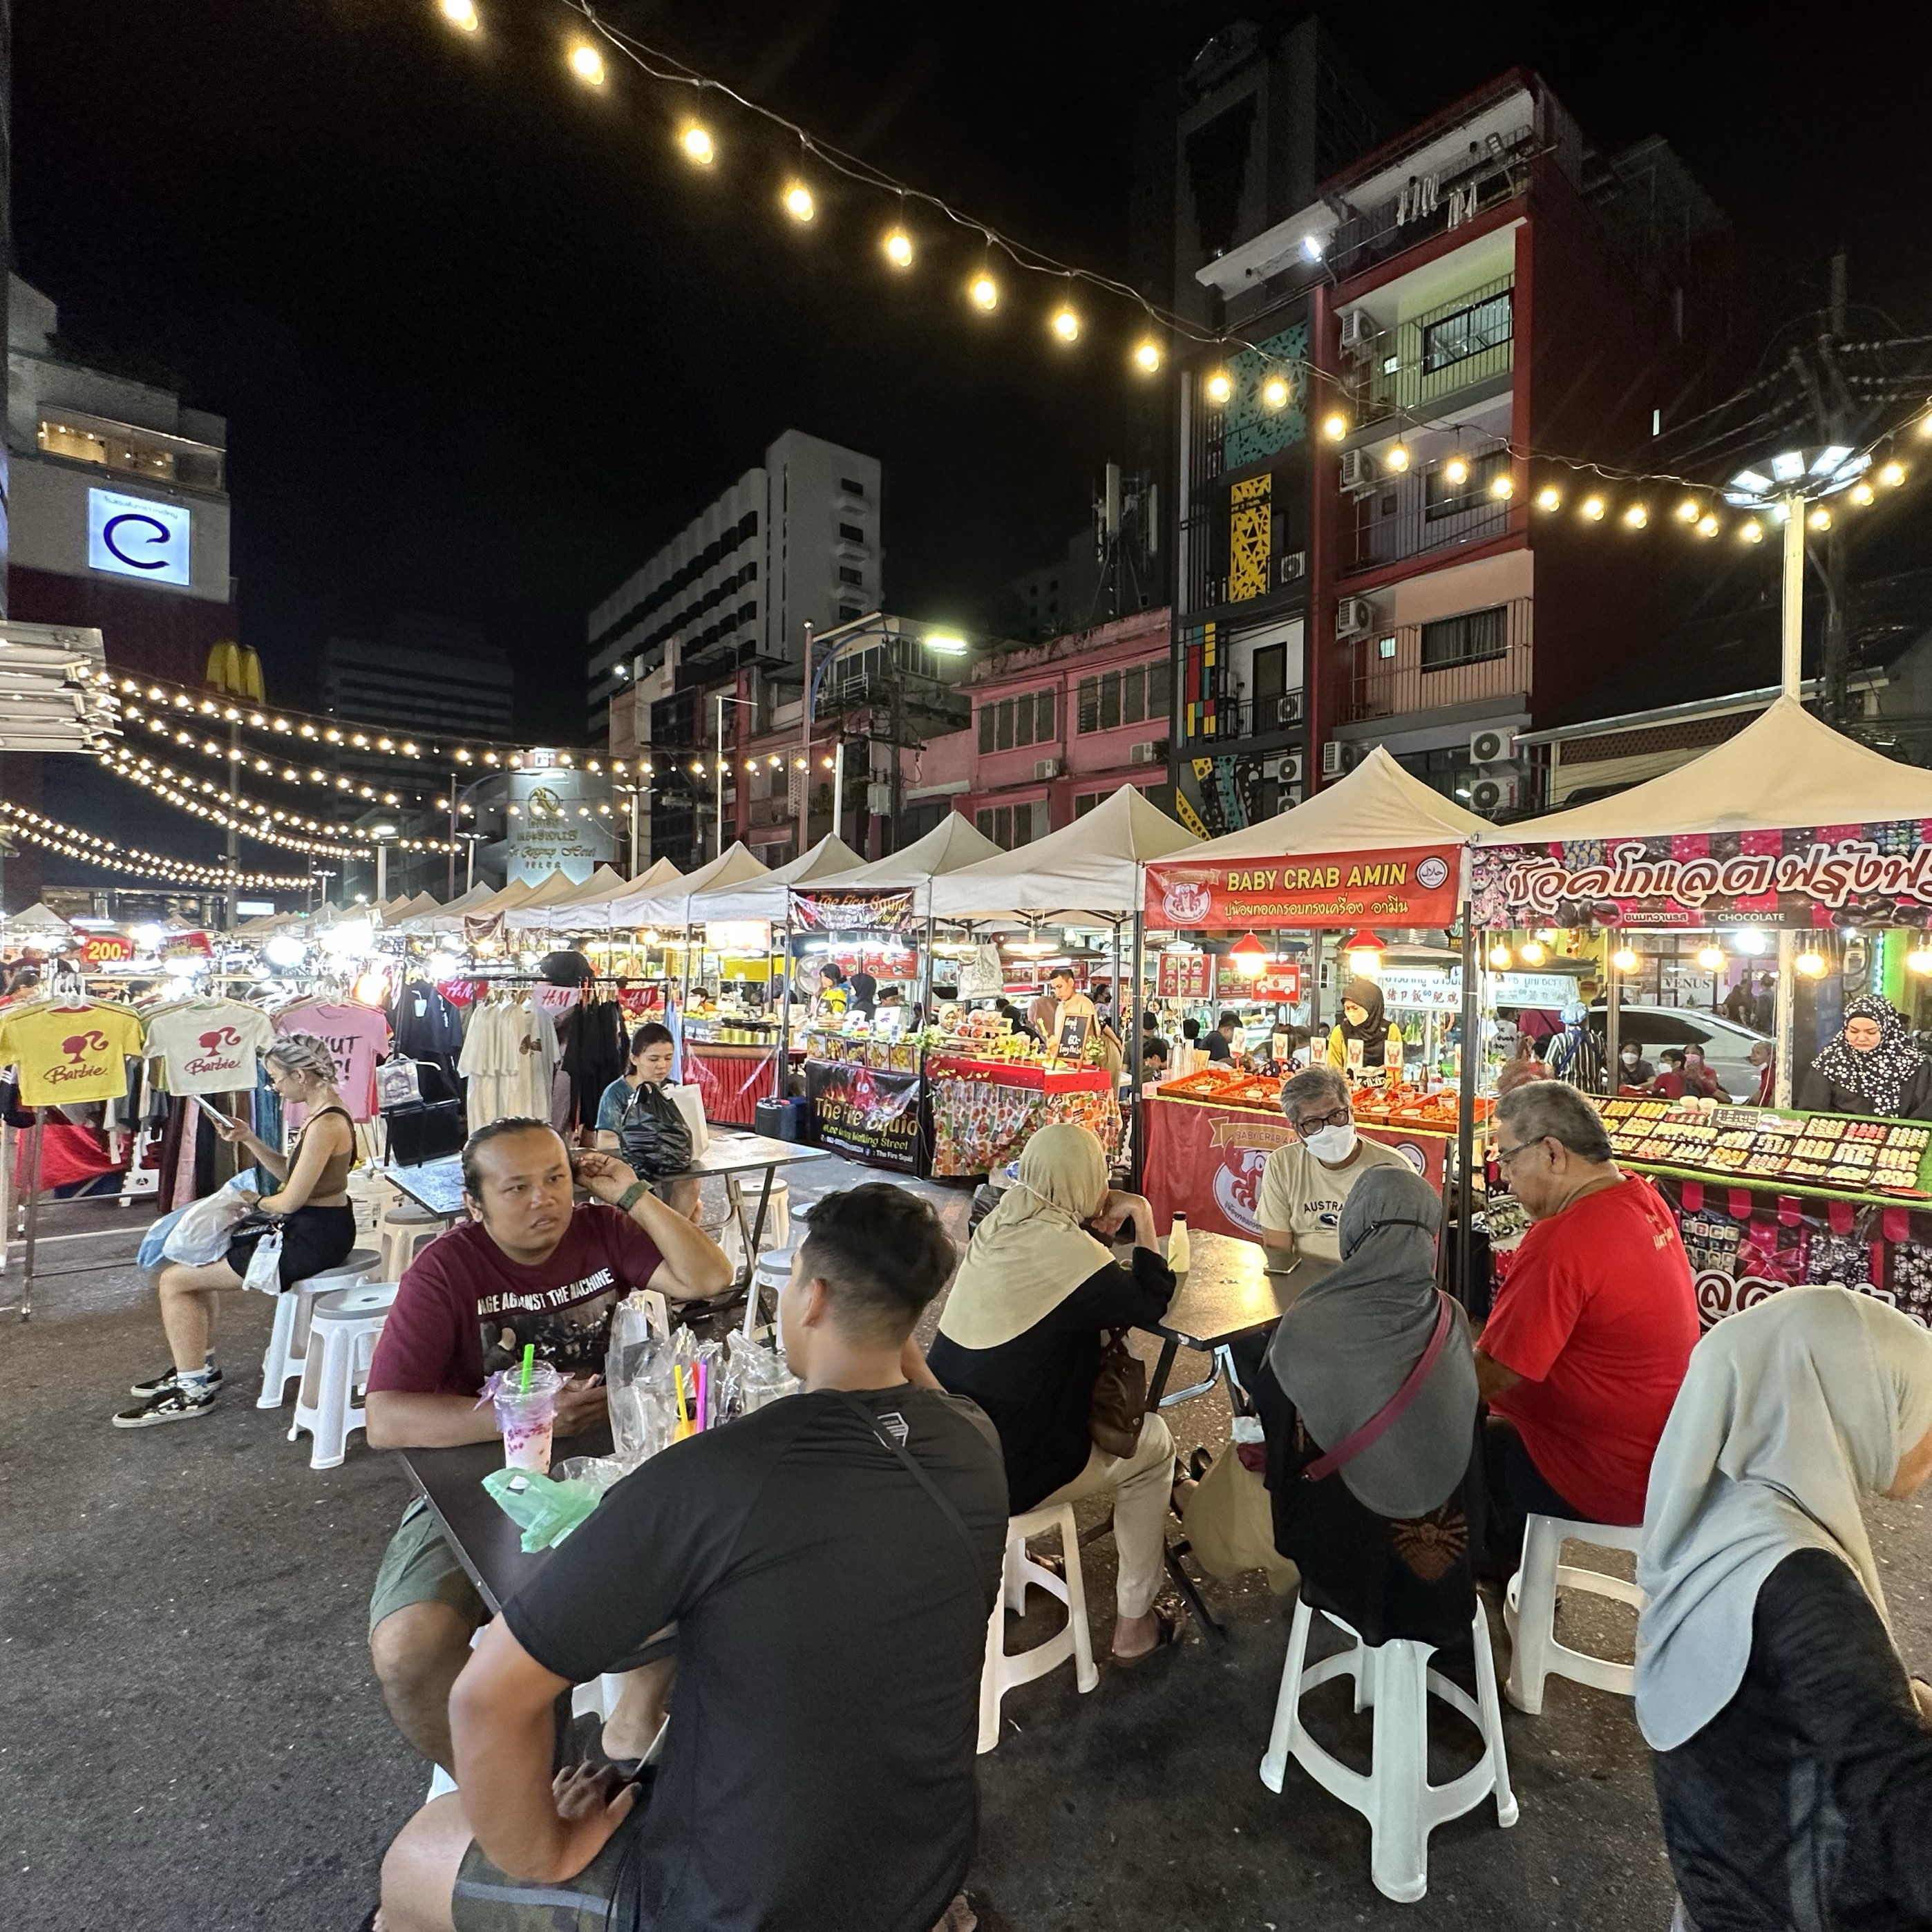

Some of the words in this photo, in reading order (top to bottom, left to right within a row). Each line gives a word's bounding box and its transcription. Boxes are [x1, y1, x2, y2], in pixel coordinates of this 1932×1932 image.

[1227, 870, 1278, 891] BABY
[1284, 866, 1339, 889] CRAB
[1347, 864, 1408, 887] AMIN
[1371, 895, 1409, 914] อามีน
[1718, 913, 1785, 922] CHOCOLATE
[1663, 978, 1710, 989] VENUS
[44, 1064, 106, 1084] Barbie
[184, 1057, 240, 1075] Barbie
[815, 1097, 841, 1120] The
[842, 1103, 864, 1126] Fire
[881, 1137, 908, 1150] Street
[1236, 1130, 1256, 1140] BABY
[1259, 1133, 1281, 1144] CRAB
[876, 1149, 887, 1158] The
[887, 1151, 898, 1159] Fire
[547, 1285, 570, 1307] THE
